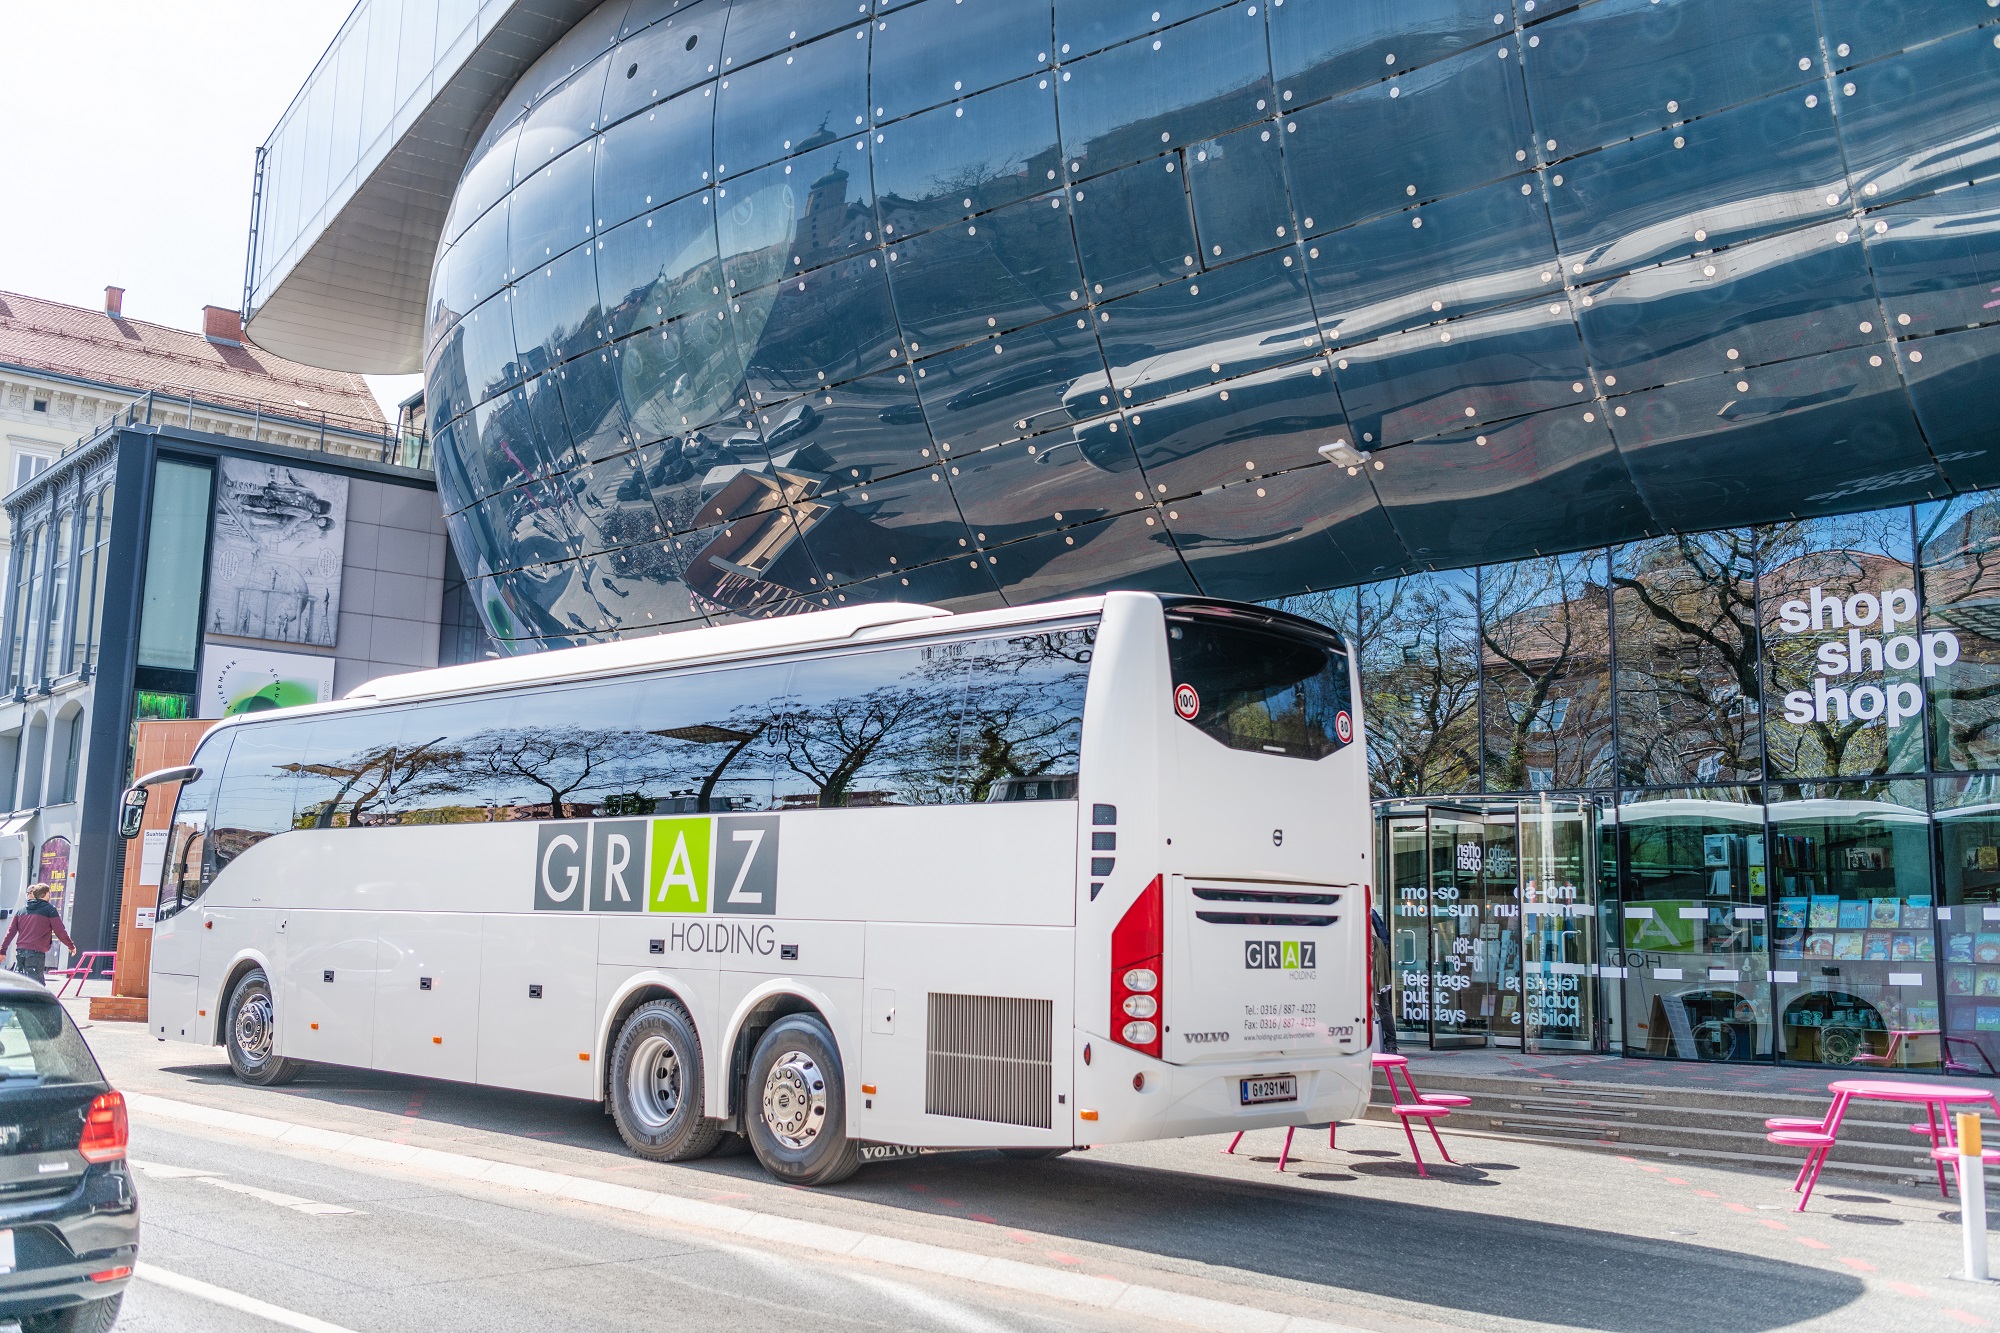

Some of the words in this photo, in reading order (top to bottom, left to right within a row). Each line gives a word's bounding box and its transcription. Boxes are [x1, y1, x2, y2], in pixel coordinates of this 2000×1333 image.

[1779, 586, 1918, 633] shop
[1817, 628, 1960, 677] shop
[217, 660, 237, 714] STEIERMARK
[1179, 693, 1195, 709] 100
[1783, 677, 1924, 728] shop
[541, 829, 766, 904] GRAZ
[671, 922, 775, 955] HOLDING
[1247, 944, 1314, 967] GRAZ
[1289, 971, 1316, 980] HOLDING
[1402, 970, 1470, 991] feietags
[1260, 1004, 1277, 1015] 0316
[1283, 1004, 1295, 1014] 887
[1301, 1003, 1316, 1014] 4222
[1260, 1018, 1277, 1029] 0316
[1283, 1018, 1295, 1028] 887
[1301, 1017, 1316, 1027] 4223
[1327, 1025, 1354, 1037] 9700
[1183, 1031, 1230, 1044] VOLVO
[861, 1144, 918, 1160] VOLVO
